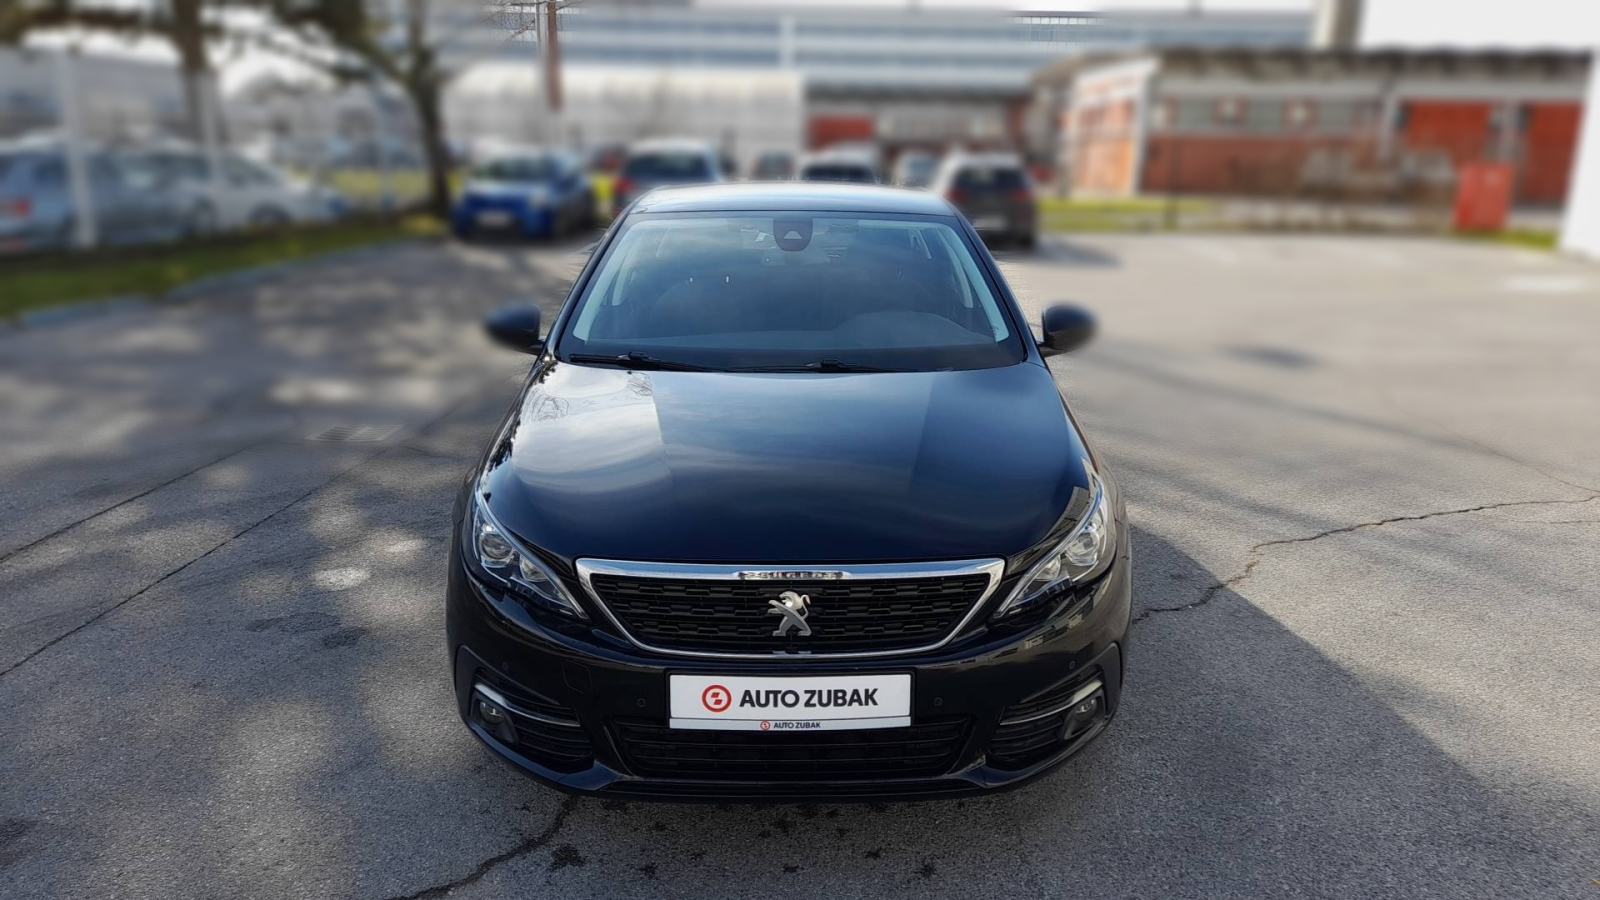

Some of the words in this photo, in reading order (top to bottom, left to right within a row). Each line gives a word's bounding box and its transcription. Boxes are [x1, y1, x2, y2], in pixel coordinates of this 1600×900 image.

[739, 689, 800, 708] AUTO
[804, 688, 879, 707] ZUBAK
[795, 721, 821, 729] ZUBAK
